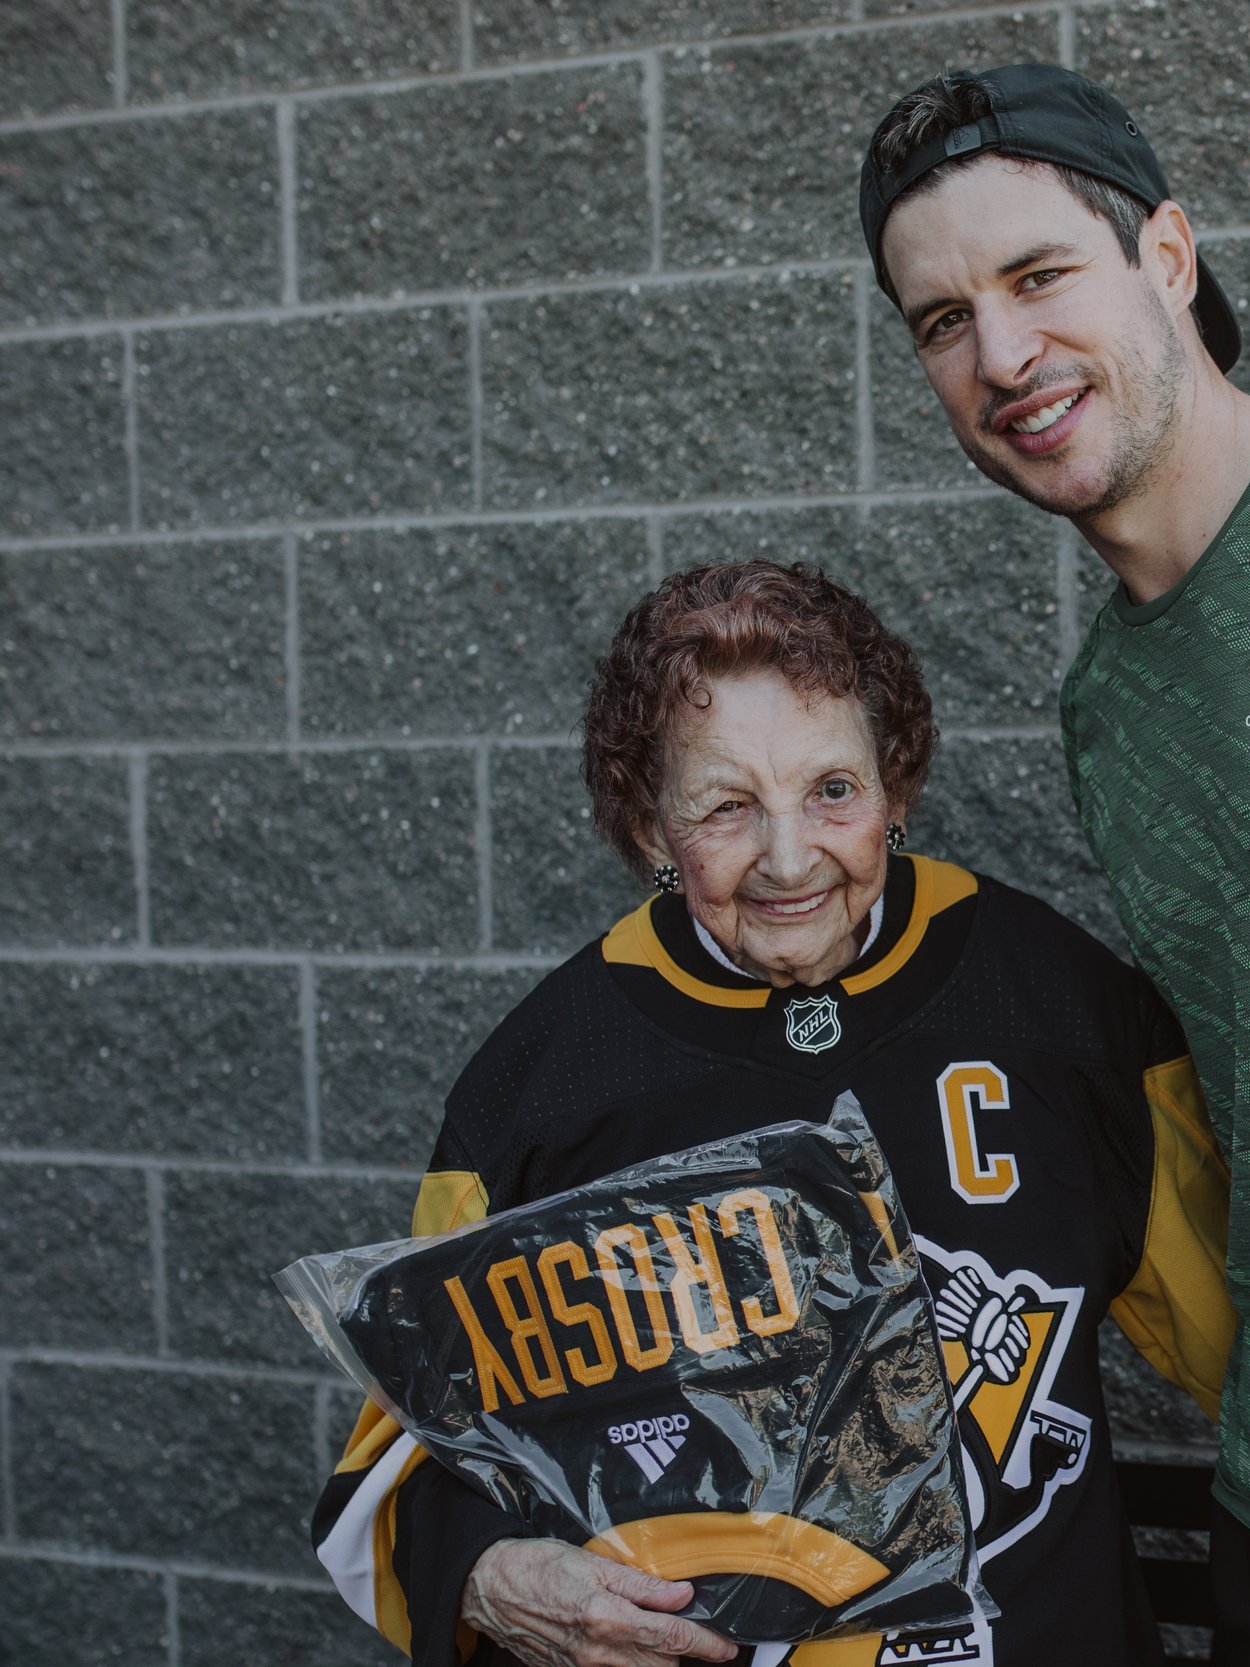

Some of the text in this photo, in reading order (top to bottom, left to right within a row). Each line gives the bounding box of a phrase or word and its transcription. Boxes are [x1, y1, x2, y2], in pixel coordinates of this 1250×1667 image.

[798, 1010, 828, 1042] NHL
[936, 1060, 1020, 1204] C
[443, 1187, 800, 1414] CROSBY
[607, 1413, 690, 1444] adidas
